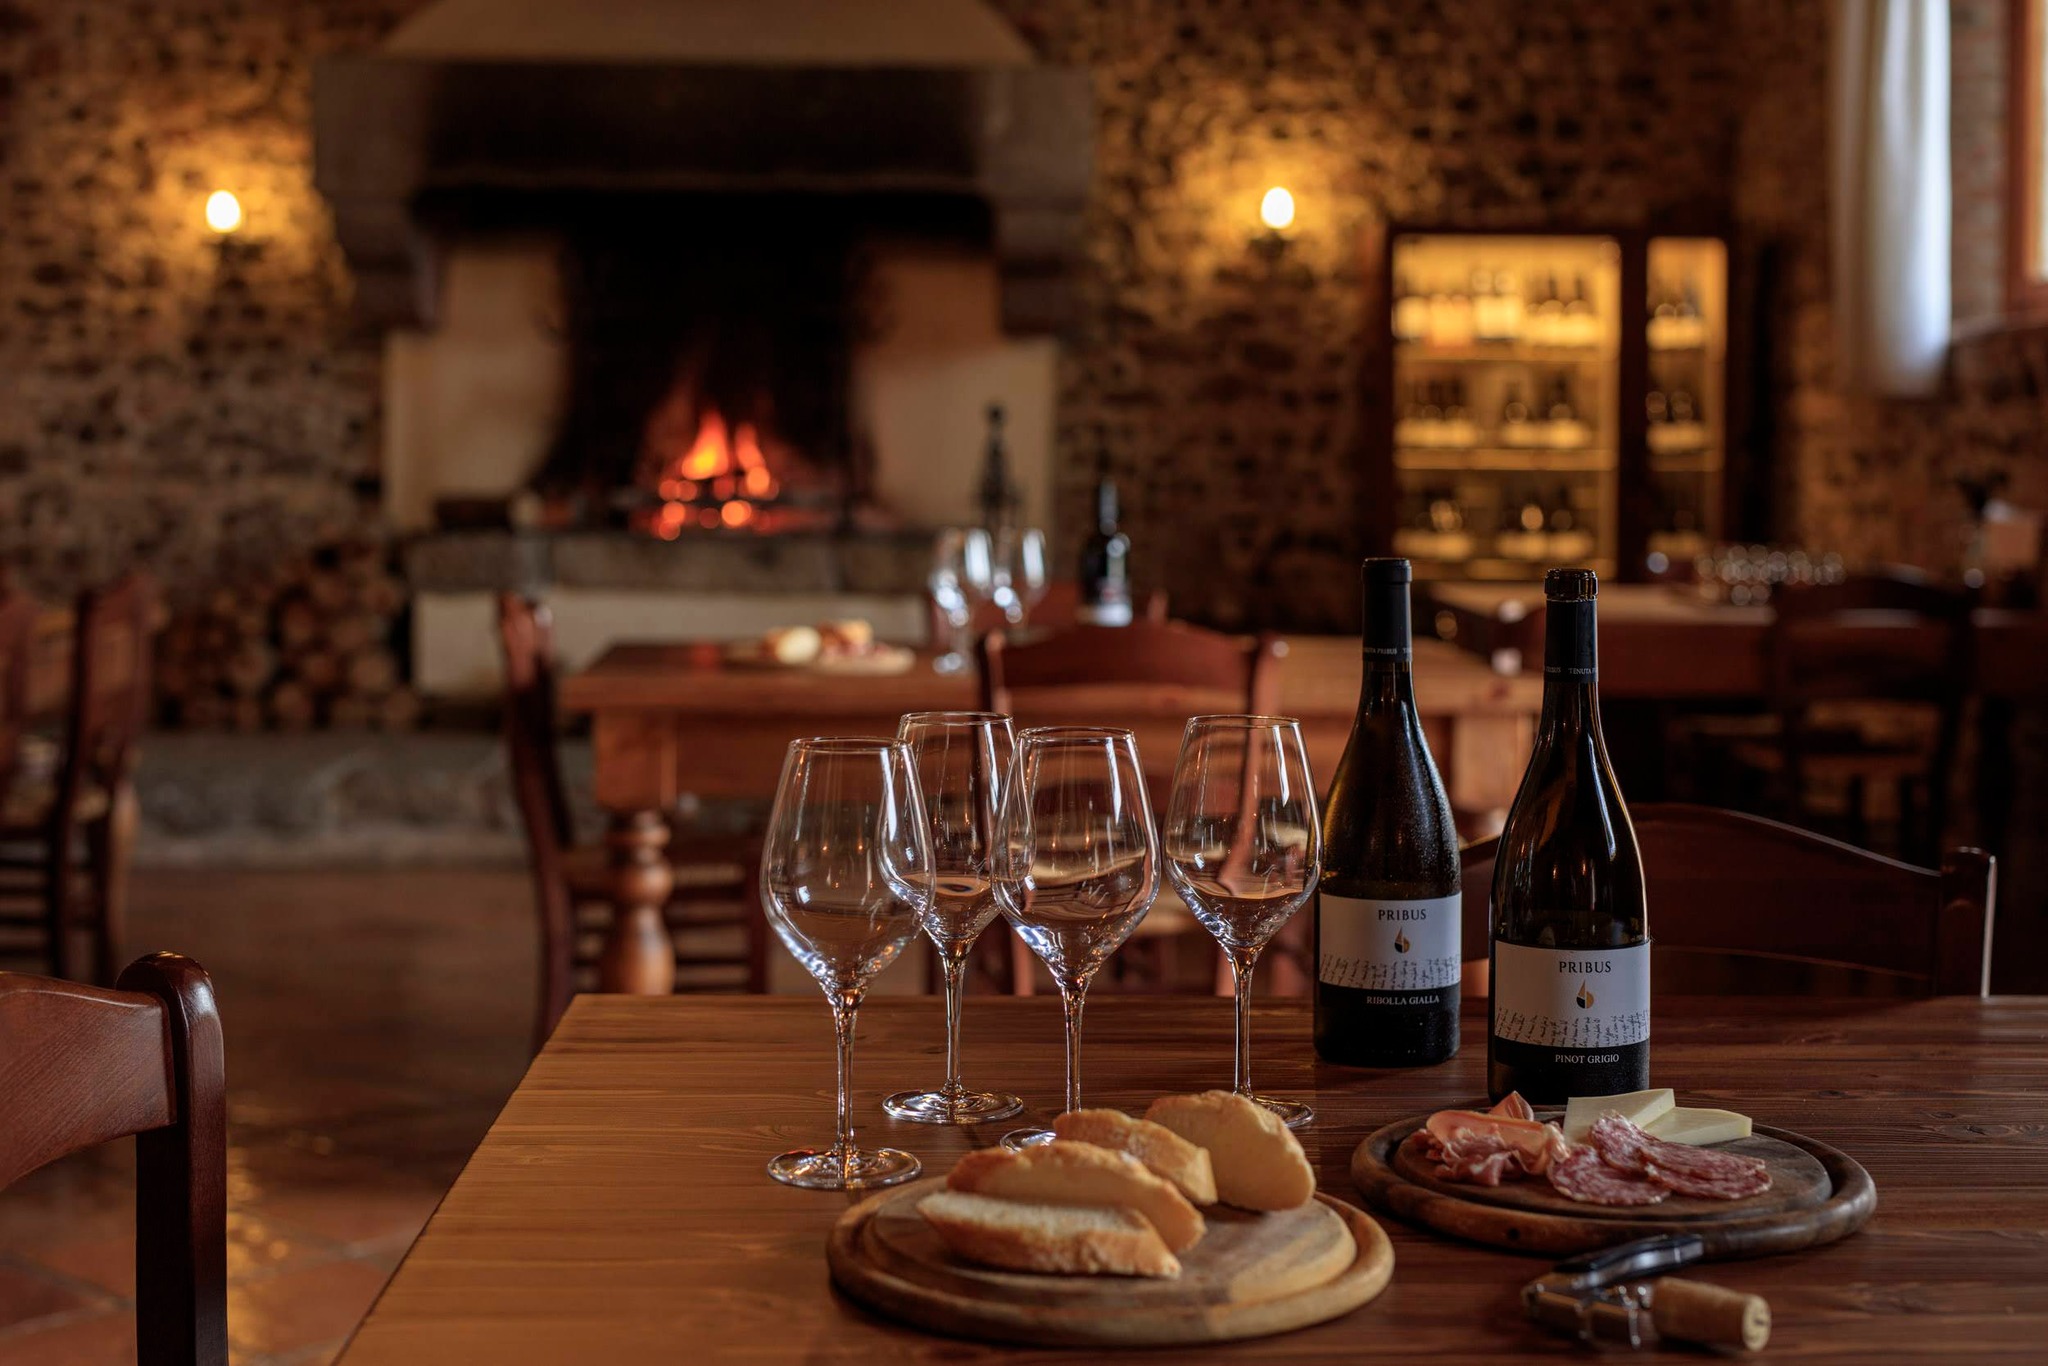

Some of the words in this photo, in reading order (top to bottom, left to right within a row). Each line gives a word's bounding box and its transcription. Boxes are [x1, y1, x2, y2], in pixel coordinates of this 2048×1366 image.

[1568, 667, 1592, 675] TENUTA
[1378, 908, 1427, 921] PRIBUS
[1558, 960, 1612, 973] PRIBUS
[1366, 996, 1407, 1006] RIBOLLA
[1408, 994, 1440, 1005] GIALLA
[1555, 1054, 1585, 1064] PINOT
[1587, 1053, 1620, 1064] GRIGIO
